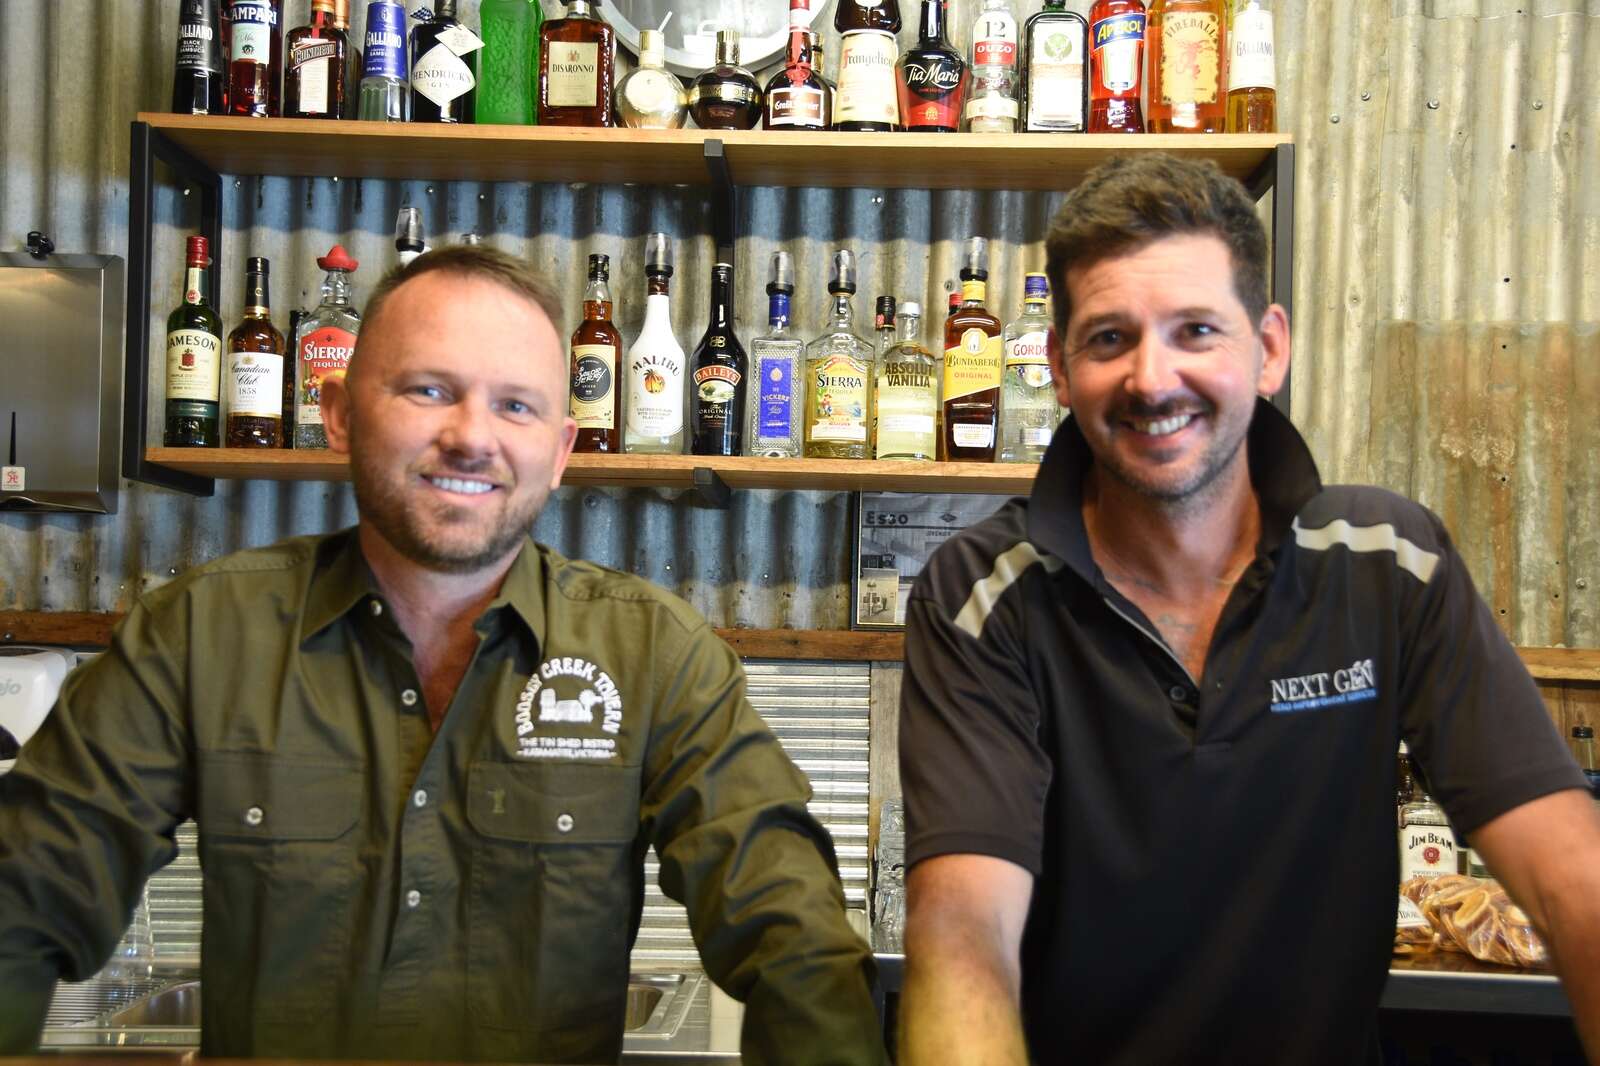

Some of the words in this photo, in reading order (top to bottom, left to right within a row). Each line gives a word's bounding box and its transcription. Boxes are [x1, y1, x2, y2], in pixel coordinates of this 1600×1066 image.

[231, 7, 278, 24] AMPARI
[180, 24, 213, 41] ALLIANO
[985, 21, 1006, 38] 12
[1097, 19, 1142, 44] APEROL
[1165, 18, 1218, 38] FIREBALL
[977, 45, 1012, 54] OUZO
[552, 63, 595, 74] DISARONNO
[904, 64, 927, 86] Tia
[921, 62, 960, 90] Maria
[167, 335, 216, 352] JAMESON
[304, 341, 354, 361] SIERRA
[1013, 344, 1048, 357] GORDO
[231, 360, 270, 374] Canadian
[313, 361, 348, 369] TEQUILA
[632, 355, 680, 376] MALIBU
[885, 362, 933, 376] ABSOLUT
[946, 353, 1000, 369] BUNDABERG
[236, 372, 259, 385] Club
[696, 367, 739, 382] BAILEYS
[816, 373, 862, 388] SIERRA
[887, 374, 931, 388] VANILIA
[954, 371, 993, 380] ORIGINAL
[239, 387, 257, 395] 1858
[1270, 672, 1329, 703] NEXT
[1333, 664, 1375, 693] GEN
[541, 657, 597, 681] CREEK
[594, 672, 622, 734] TAVERN
[1409, 835, 1426, 850] JIM
[1428, 832, 1453, 851] BEAM
